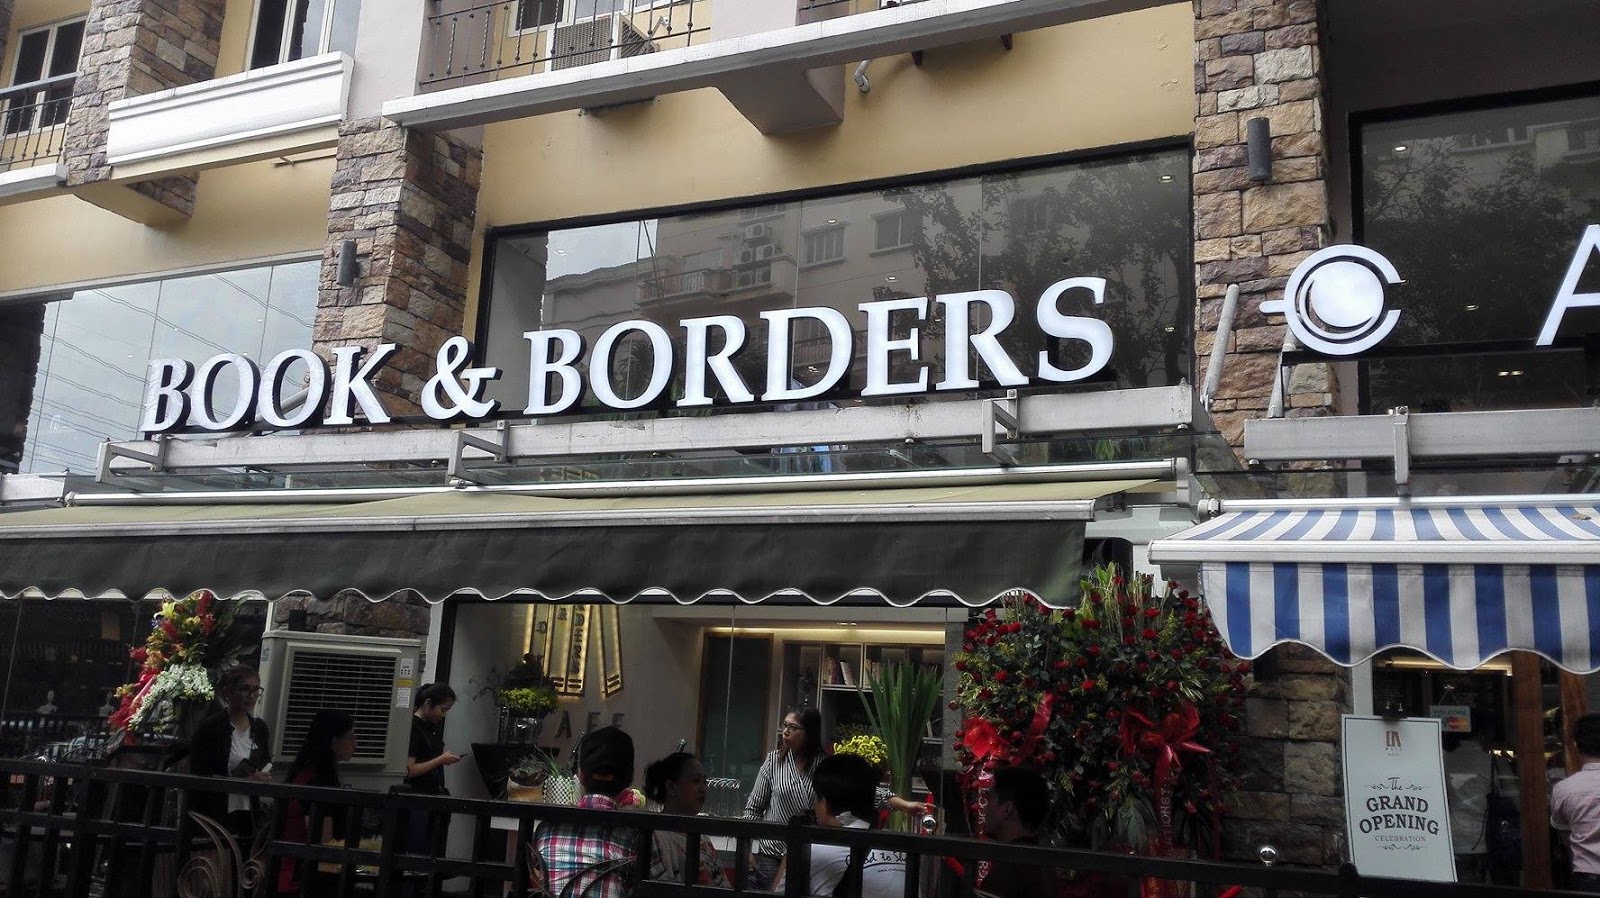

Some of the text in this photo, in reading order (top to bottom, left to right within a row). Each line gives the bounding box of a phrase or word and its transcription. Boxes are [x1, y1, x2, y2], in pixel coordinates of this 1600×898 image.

[140, 275, 1114, 434] BOOK & BORDERS
[1388, 777, 1403, 791] The
[1366, 795, 1429, 813] GRAND
[1359, 814, 1440, 836] OPENING
